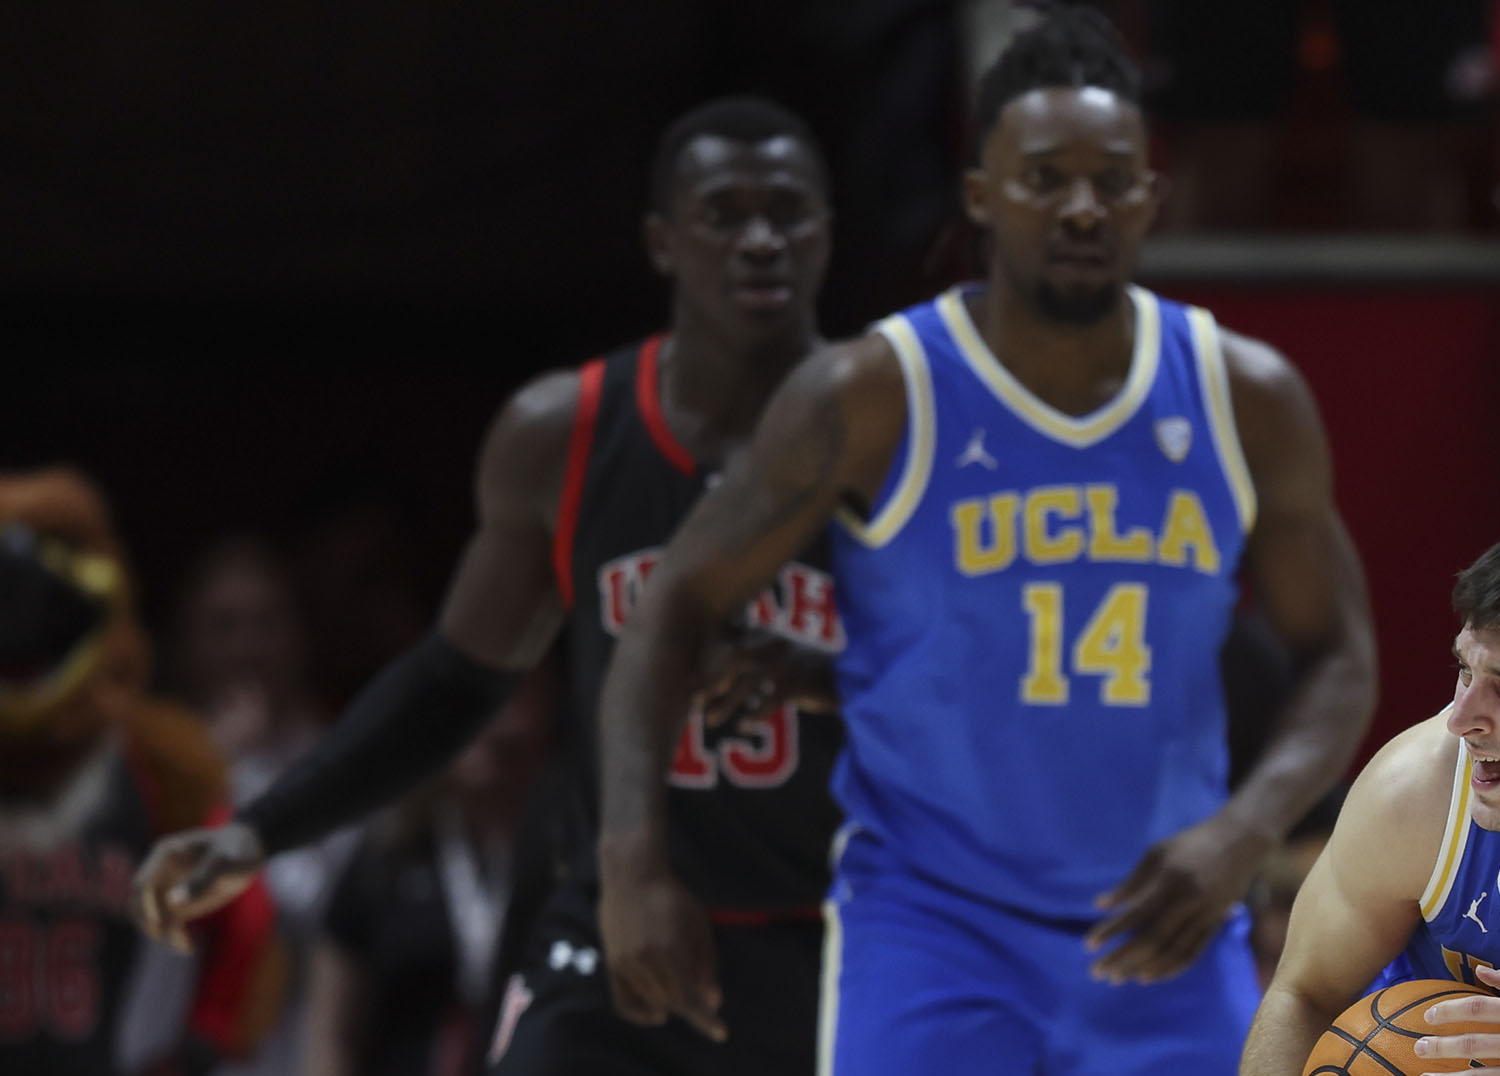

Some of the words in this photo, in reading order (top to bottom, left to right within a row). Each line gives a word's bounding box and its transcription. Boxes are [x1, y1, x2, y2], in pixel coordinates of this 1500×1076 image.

[951, 482, 1221, 576] UCLA
[598, 548, 847, 655] UH
[1020, 581, 1152, 707] 14
